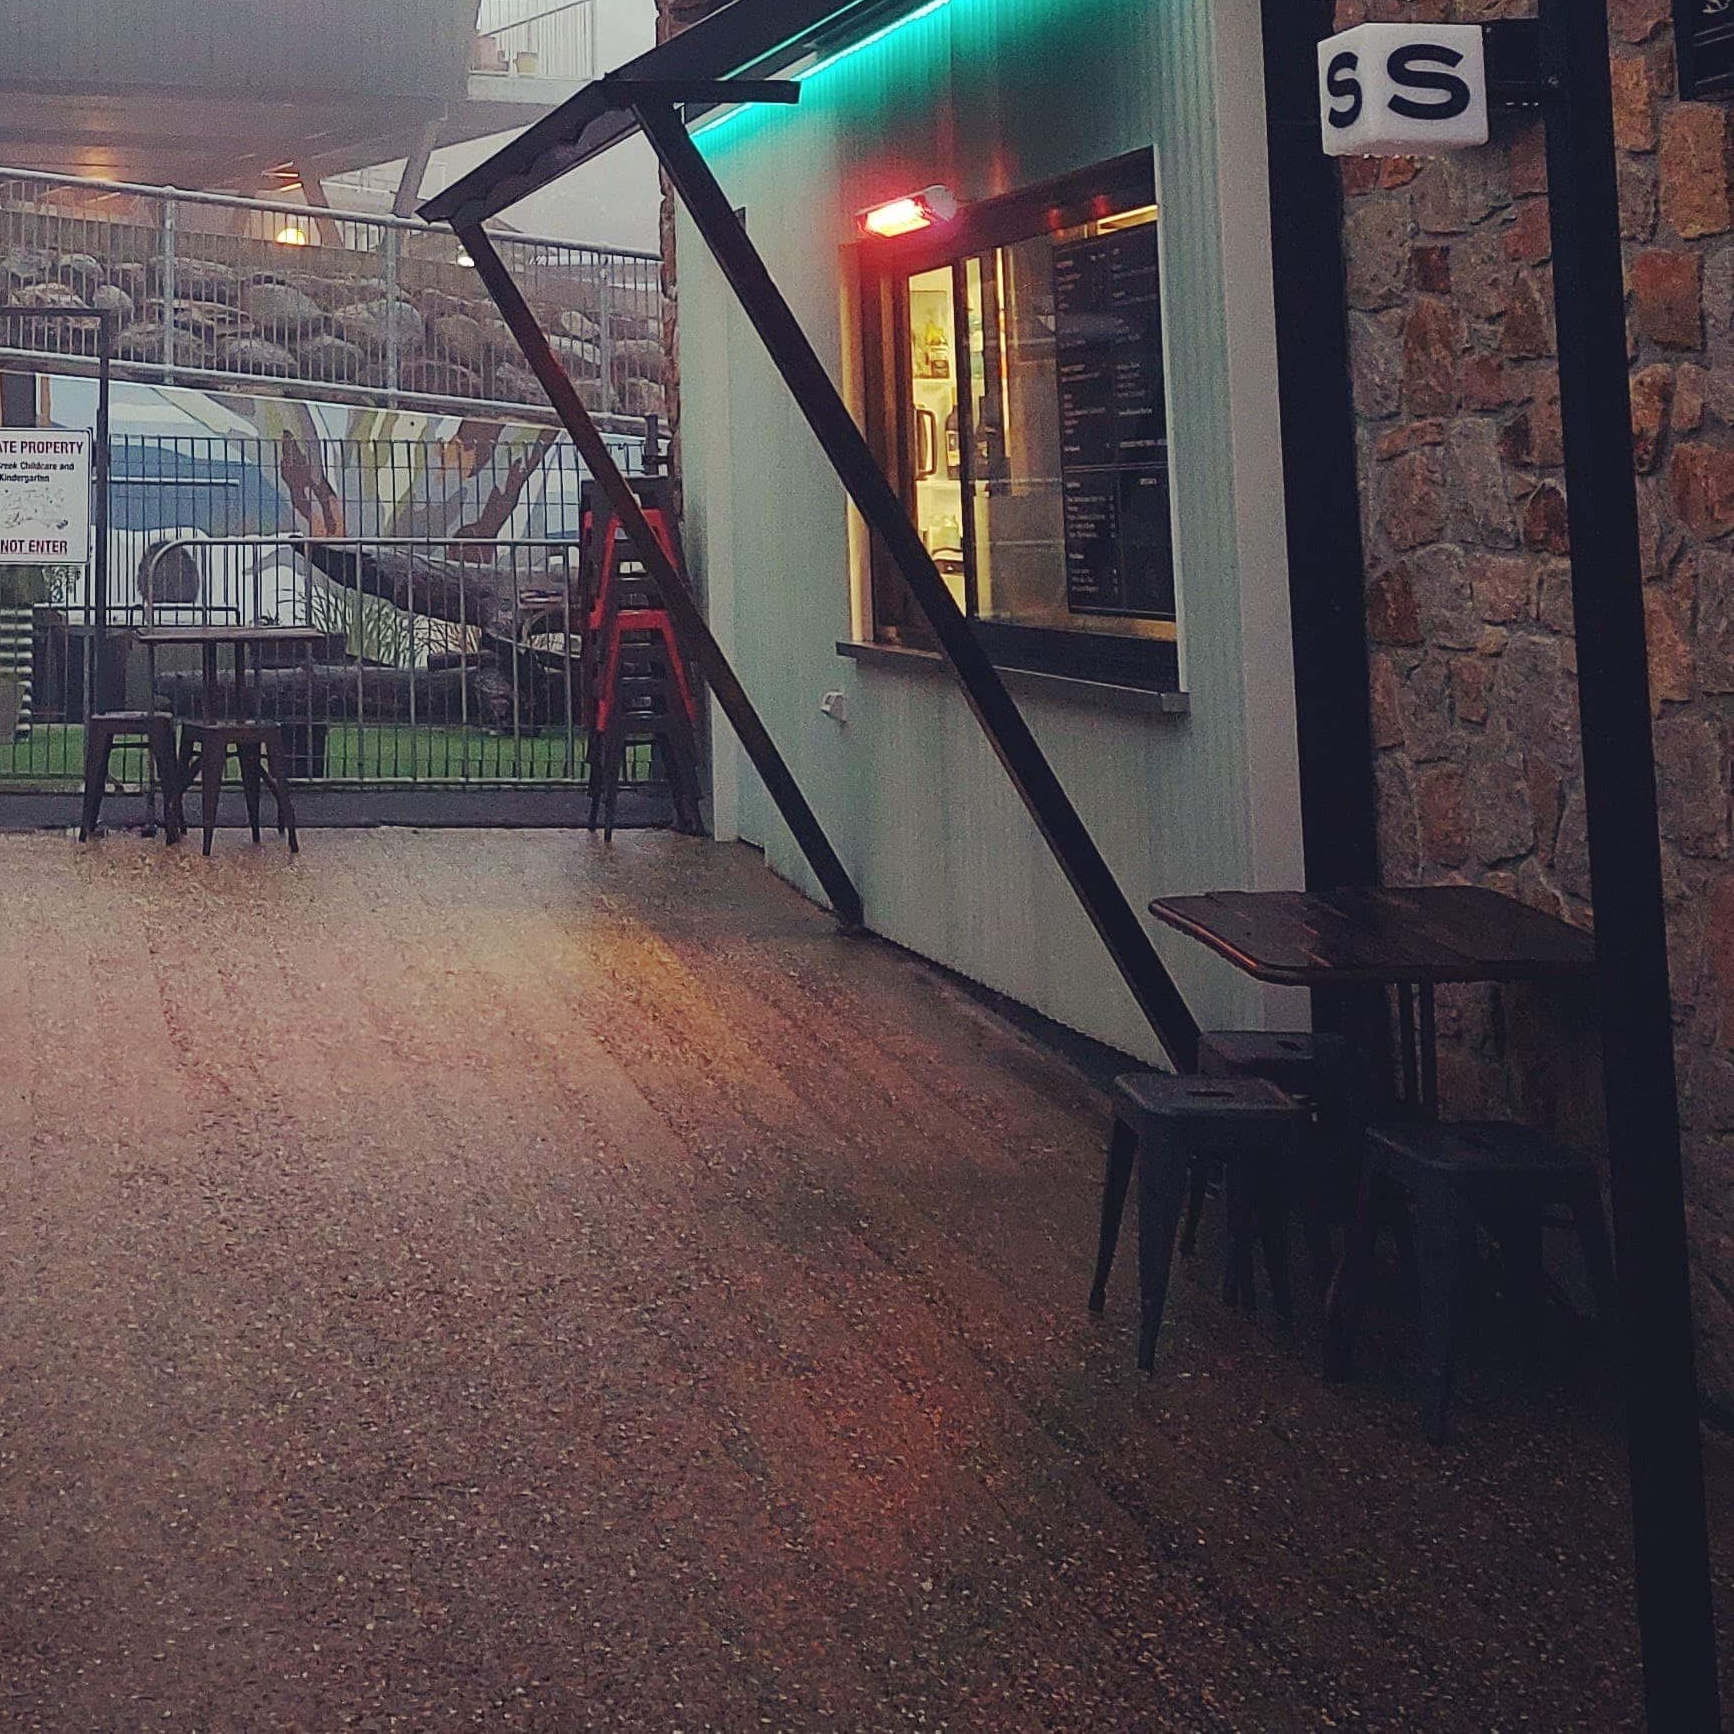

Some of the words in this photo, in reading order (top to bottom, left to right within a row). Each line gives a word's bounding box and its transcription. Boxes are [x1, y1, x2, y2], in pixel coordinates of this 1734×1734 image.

[20, 441, 84, 454] PROPERTY
[20, 461, 57, 470] Childcare
[59, 462, 75, 470] and
[0, 539, 25, 553] NOT
[28, 540, 68, 554] ENTER
